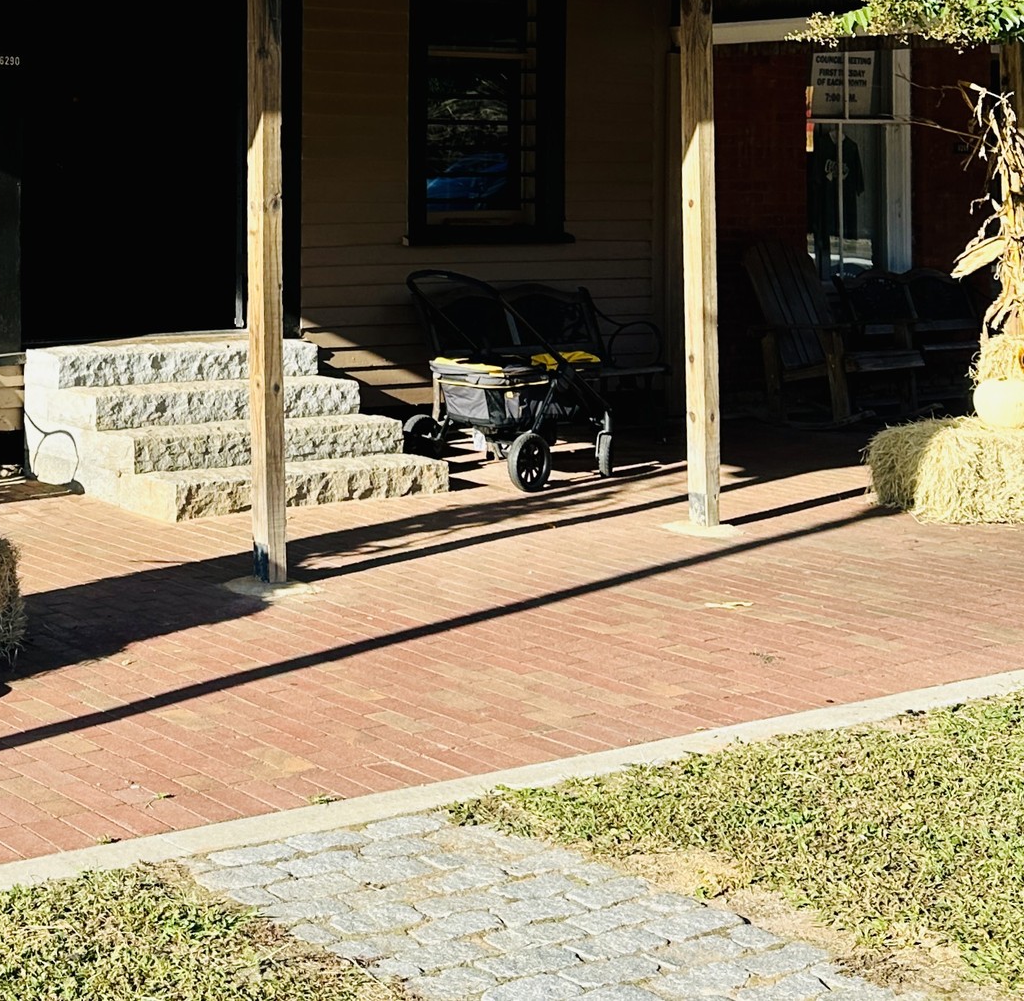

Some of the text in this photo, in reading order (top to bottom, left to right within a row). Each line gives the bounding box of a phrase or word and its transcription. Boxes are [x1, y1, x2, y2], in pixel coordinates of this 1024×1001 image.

[0, 56, 20, 66] 6290
[816, 55, 844, 64] COUNCIL
[819, 68, 866, 78] FIRST TSDAY
[816, 78, 826, 86] OF
[826, 78, 844, 86] EACH
[825, 92, 841, 103] 7:00
